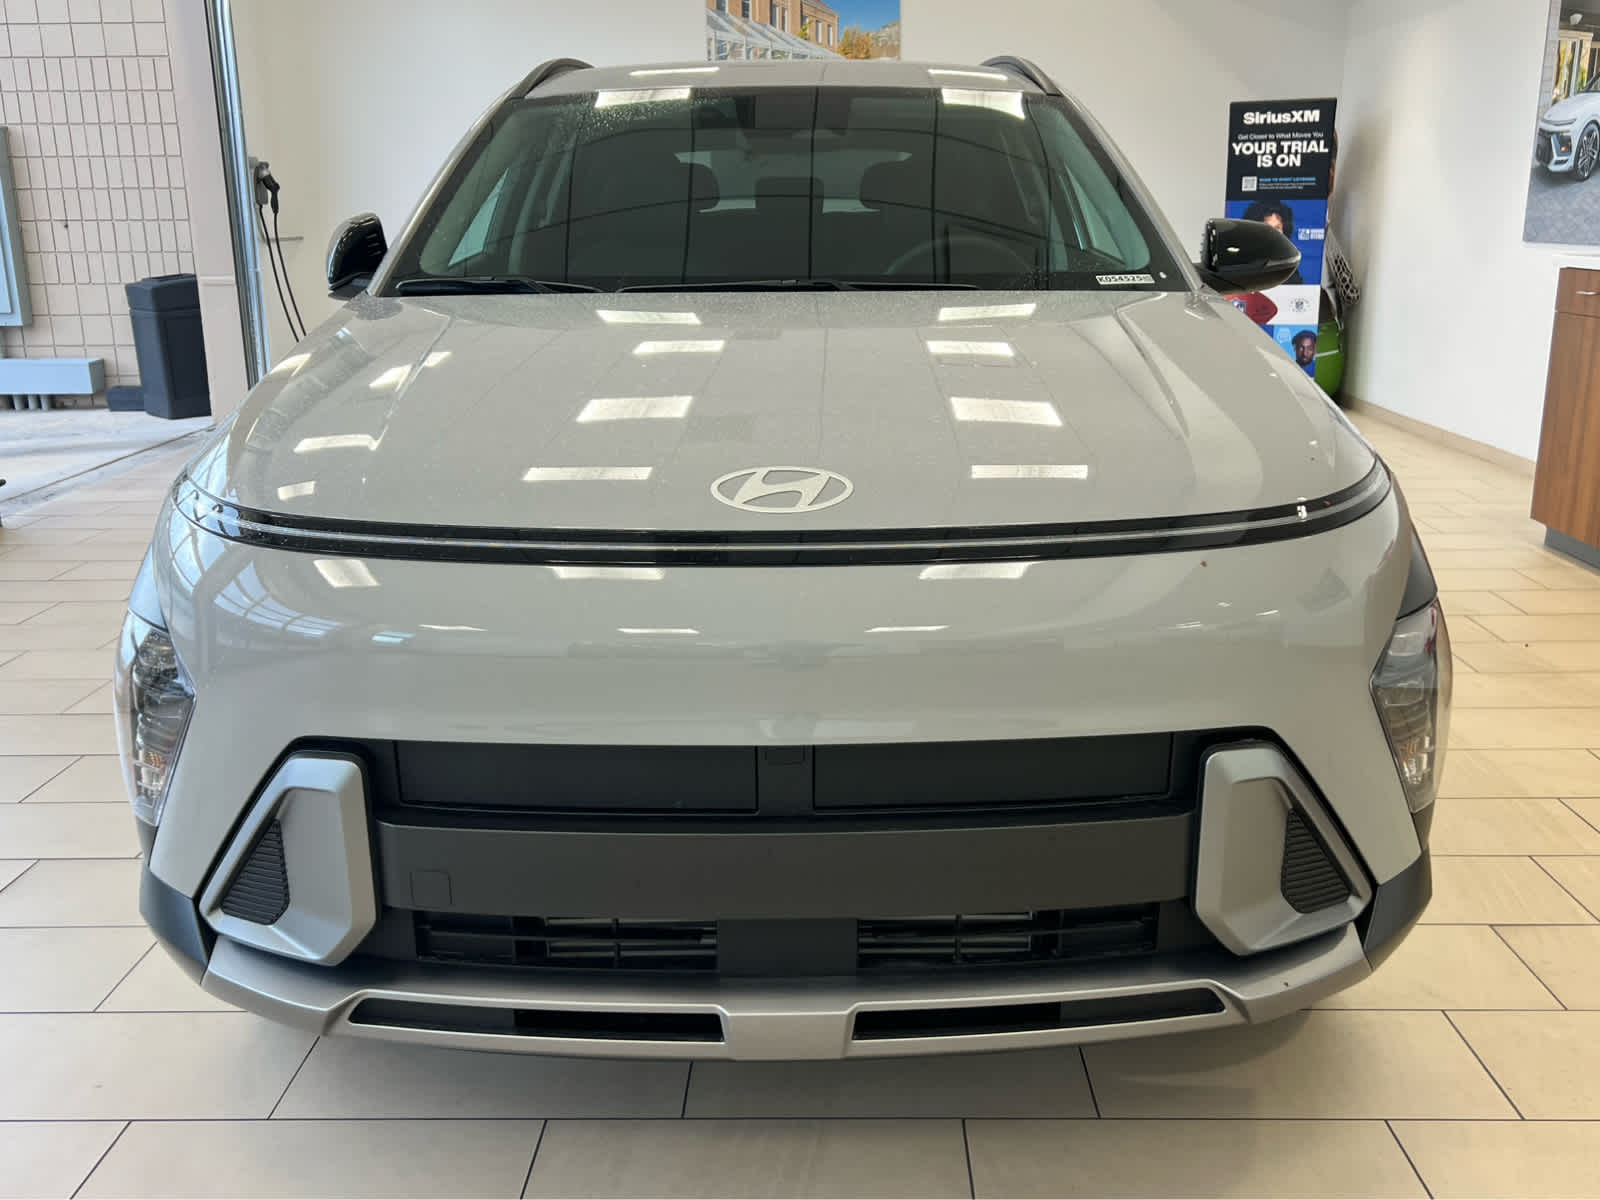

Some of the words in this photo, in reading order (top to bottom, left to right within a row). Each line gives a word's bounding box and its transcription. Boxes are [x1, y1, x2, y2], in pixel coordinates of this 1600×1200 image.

[1243, 110, 1320, 125] SiriusXM
[1232, 141, 1277, 155] YOUR
[1280, 140, 1328, 154] TRIAL
[1256, 154, 1273, 168] IS
[1276, 153, 1301, 167] ON
